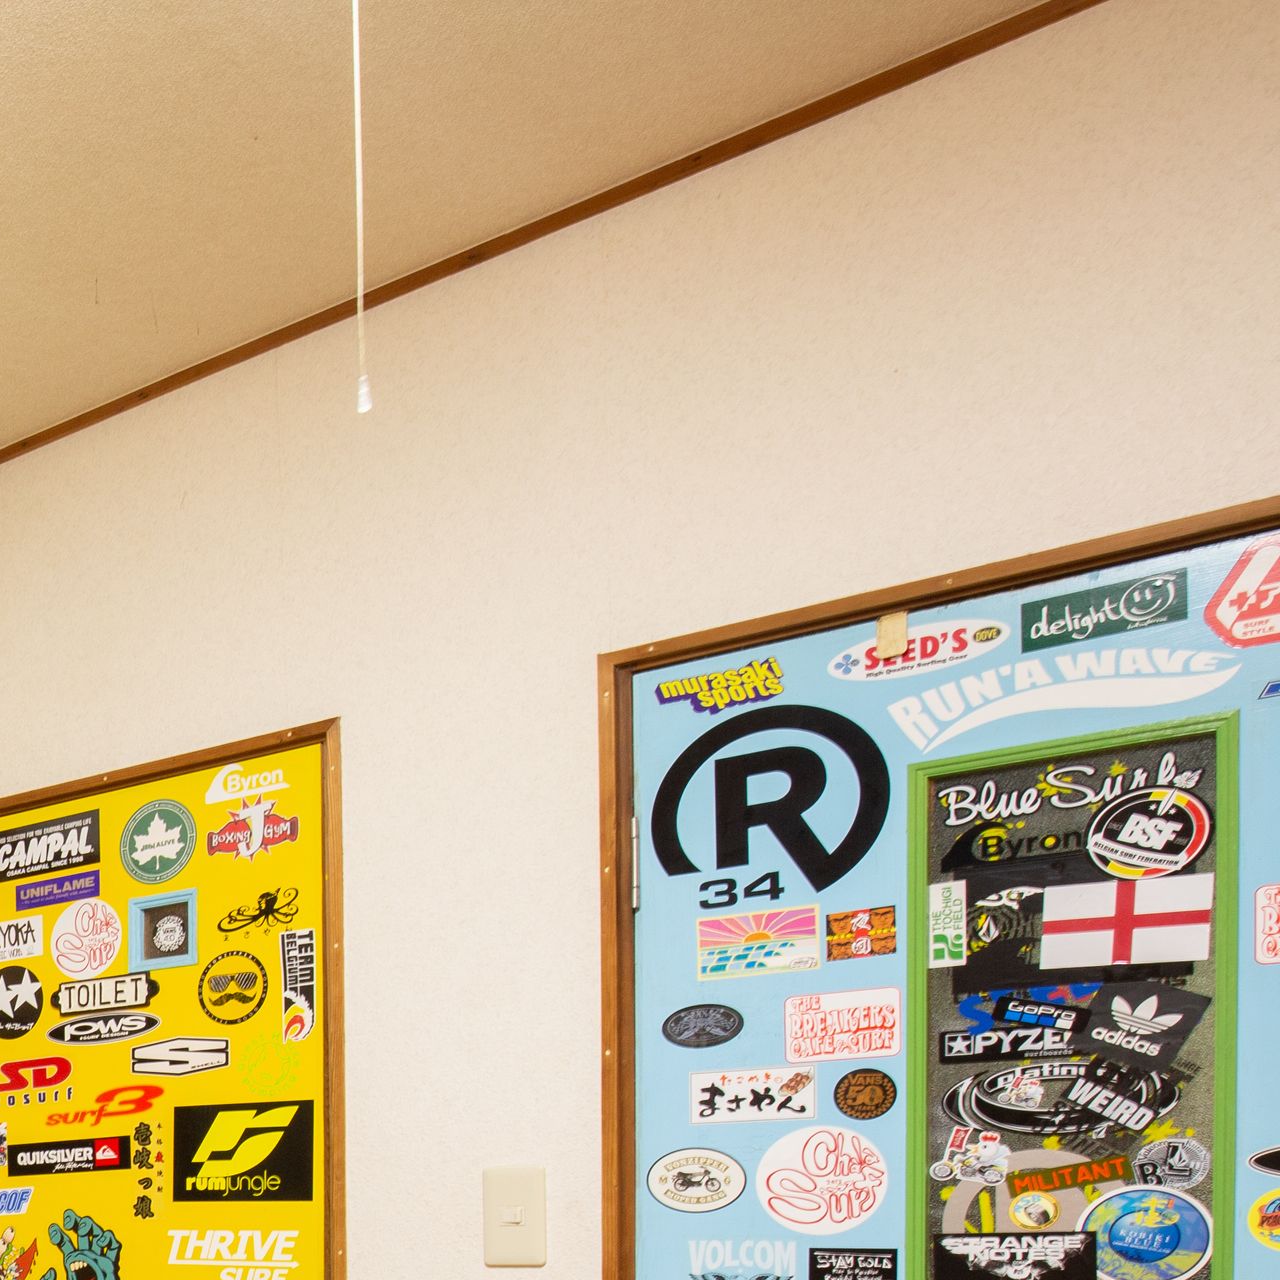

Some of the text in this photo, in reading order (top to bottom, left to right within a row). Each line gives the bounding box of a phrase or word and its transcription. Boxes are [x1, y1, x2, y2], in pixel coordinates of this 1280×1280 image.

[1030, 597, 1123, 640] delight
[864, 628, 969, 671] SED'S
[1054, 645, 1242, 681] WAVE
[658, 656, 784, 700] murasaki
[696, 677, 785, 710] sports
[226, 768, 284, 793] Byron
[938, 780, 1041, 826] Blue
[264, 822, 291, 838] GYM
[1116, 812, 1184, 851] BSF
[6, 859, 68, 878] OSAKA CAMPAL SINCE
[20, 876, 95, 900] UNIFLAME
[699, 871, 785, 909] 34
[932, 910, 942, 933] THE
[942, 886, 953, 933] TOCHIGI
[953, 898, 963, 933] FIELD
[298, 930, 313, 985] TEAM
[64, 977, 143, 1009] TOILET
[791, 996, 821, 1011] THE
[790, 1004, 897, 1039] BREAKERS
[790, 1030, 896, 1058] CAFE SURF
[1091, 1026, 1161, 1057] adidas
[847, 1073, 884, 1085] VANS
[699, 1082, 807, 1118] まさやん
[1067, 1078, 1156, 1131] WEIRD
[17, 1147, 93, 1167] QUIKSILVER
[133, 1122, 154, 1219] 壱岐っ娘
[1012, 1159, 1128, 1195] MILITANT
[167, 1229, 299, 1264] THRIVE
[688, 1239, 797, 1276] VOLCOM
[940, 1234, 1085, 1250] STRANGE
[966, 1248, 1067, 1263] NOTES
